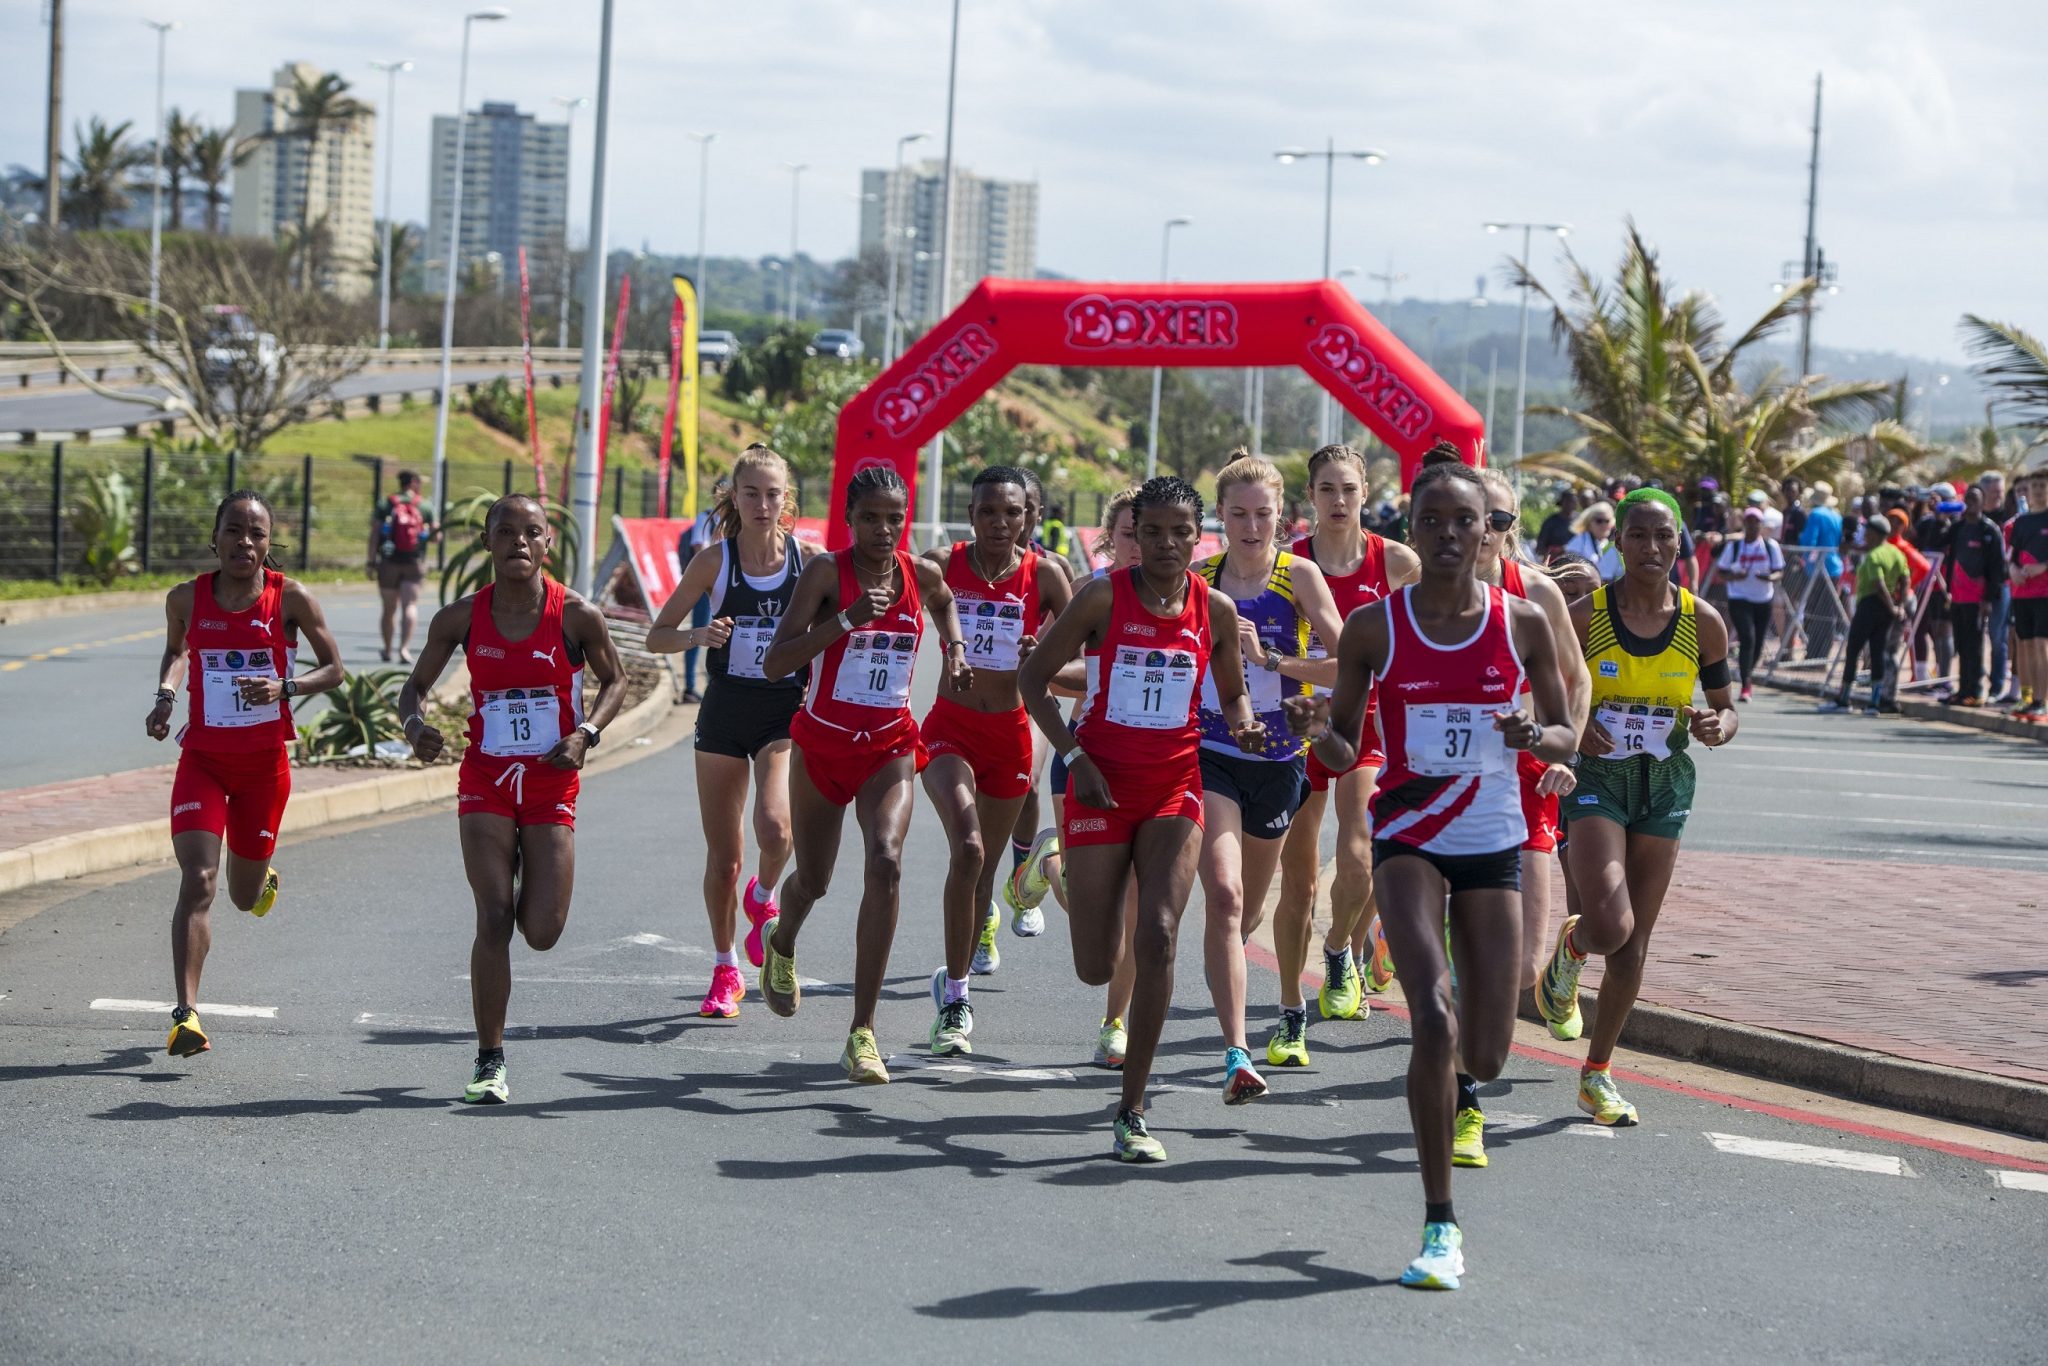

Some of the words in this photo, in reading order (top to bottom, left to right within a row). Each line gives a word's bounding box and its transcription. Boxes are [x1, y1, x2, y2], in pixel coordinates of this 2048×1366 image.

[1064, 294, 1238, 350] BOXER
[874, 323, 998, 437] BOXER
[1308, 323, 1432, 440] BOXER
[1001, 606, 1018, 614] ASA
[976, 623, 994, 631] RUN
[896, 636, 912, 645] ASA
[973, 634, 994, 655] 24
[250, 651, 268, 660] ASA
[755, 645, 768, 665] 2
[871, 656, 889, 665] RUN
[869, 668, 888, 692] 10
[1144, 674, 1164, 683] RUN
[1482, 683, 1505, 692] sport
[1142, 687, 1162, 712] 11
[509, 705, 528, 714] RUN
[1446, 713, 1471, 723] RUN
[510, 718, 531, 741] 13
[1624, 721, 1644, 731] RUN
[1445, 728, 1472, 758] 37
[1623, 733, 1644, 751] 16
